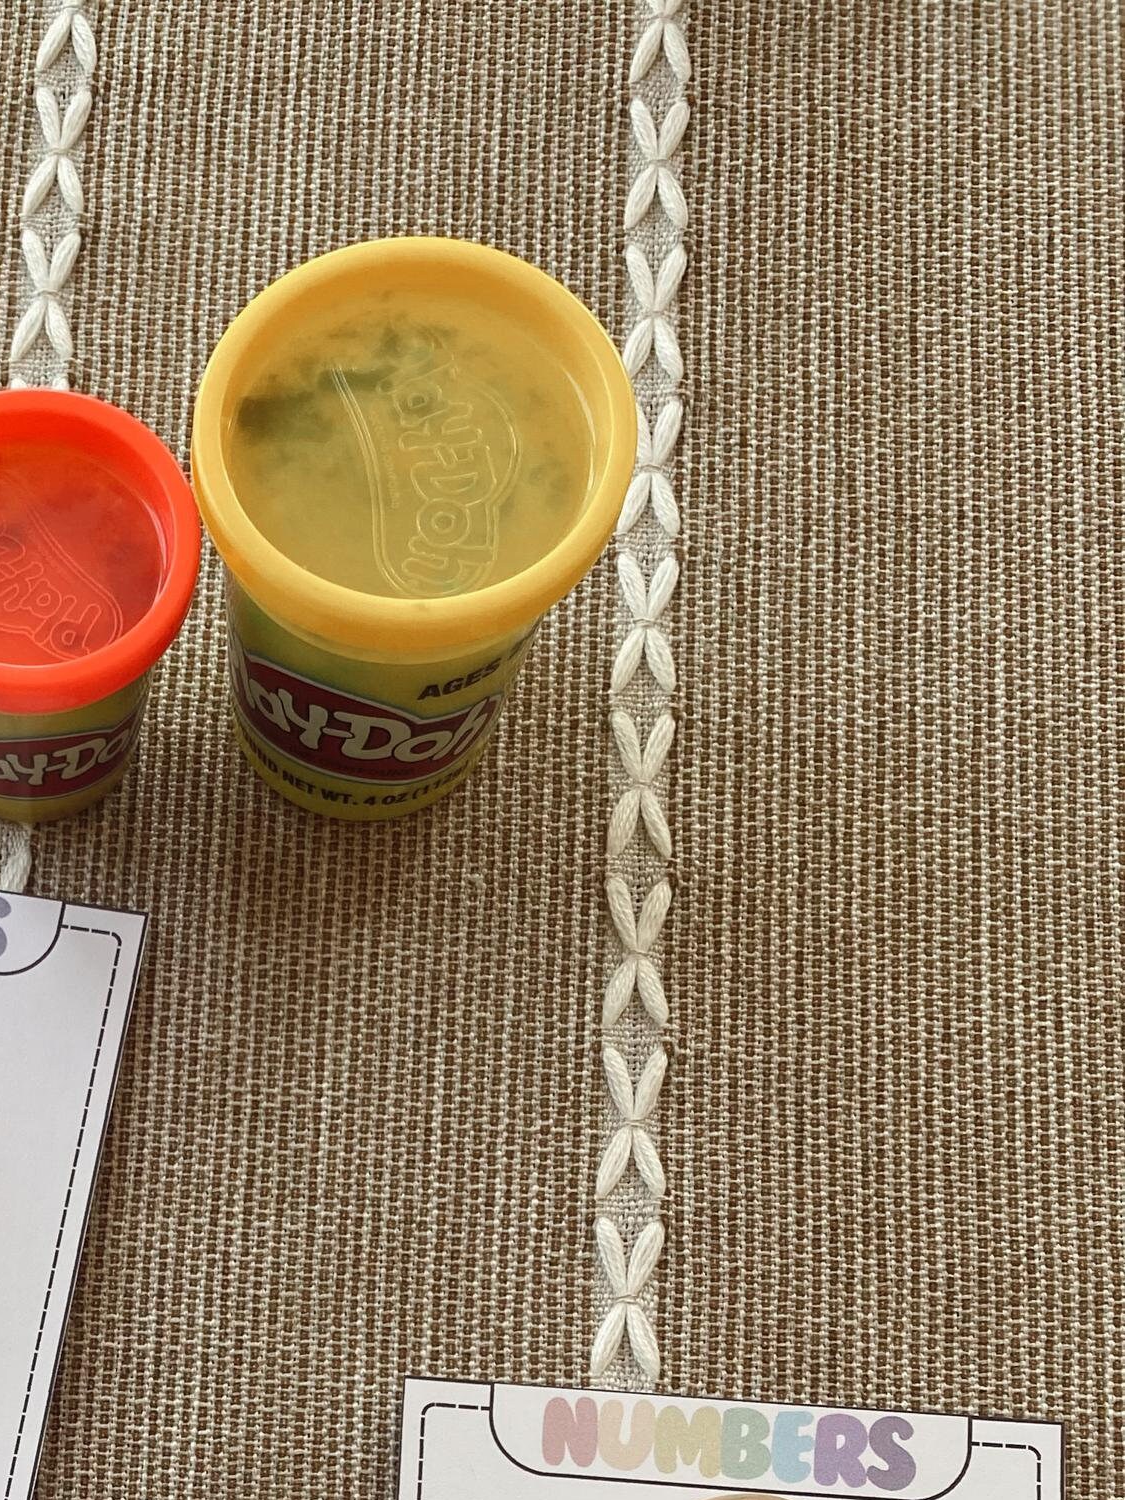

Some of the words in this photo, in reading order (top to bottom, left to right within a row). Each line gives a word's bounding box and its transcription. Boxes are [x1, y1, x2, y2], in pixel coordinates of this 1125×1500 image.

[378, 330, 497, 588] lay-Doh
[231, 634, 489, 763] lay-Doh
[417, 658, 503, 701] AGES
[541, 1396, 917, 1492] NUMBERS
